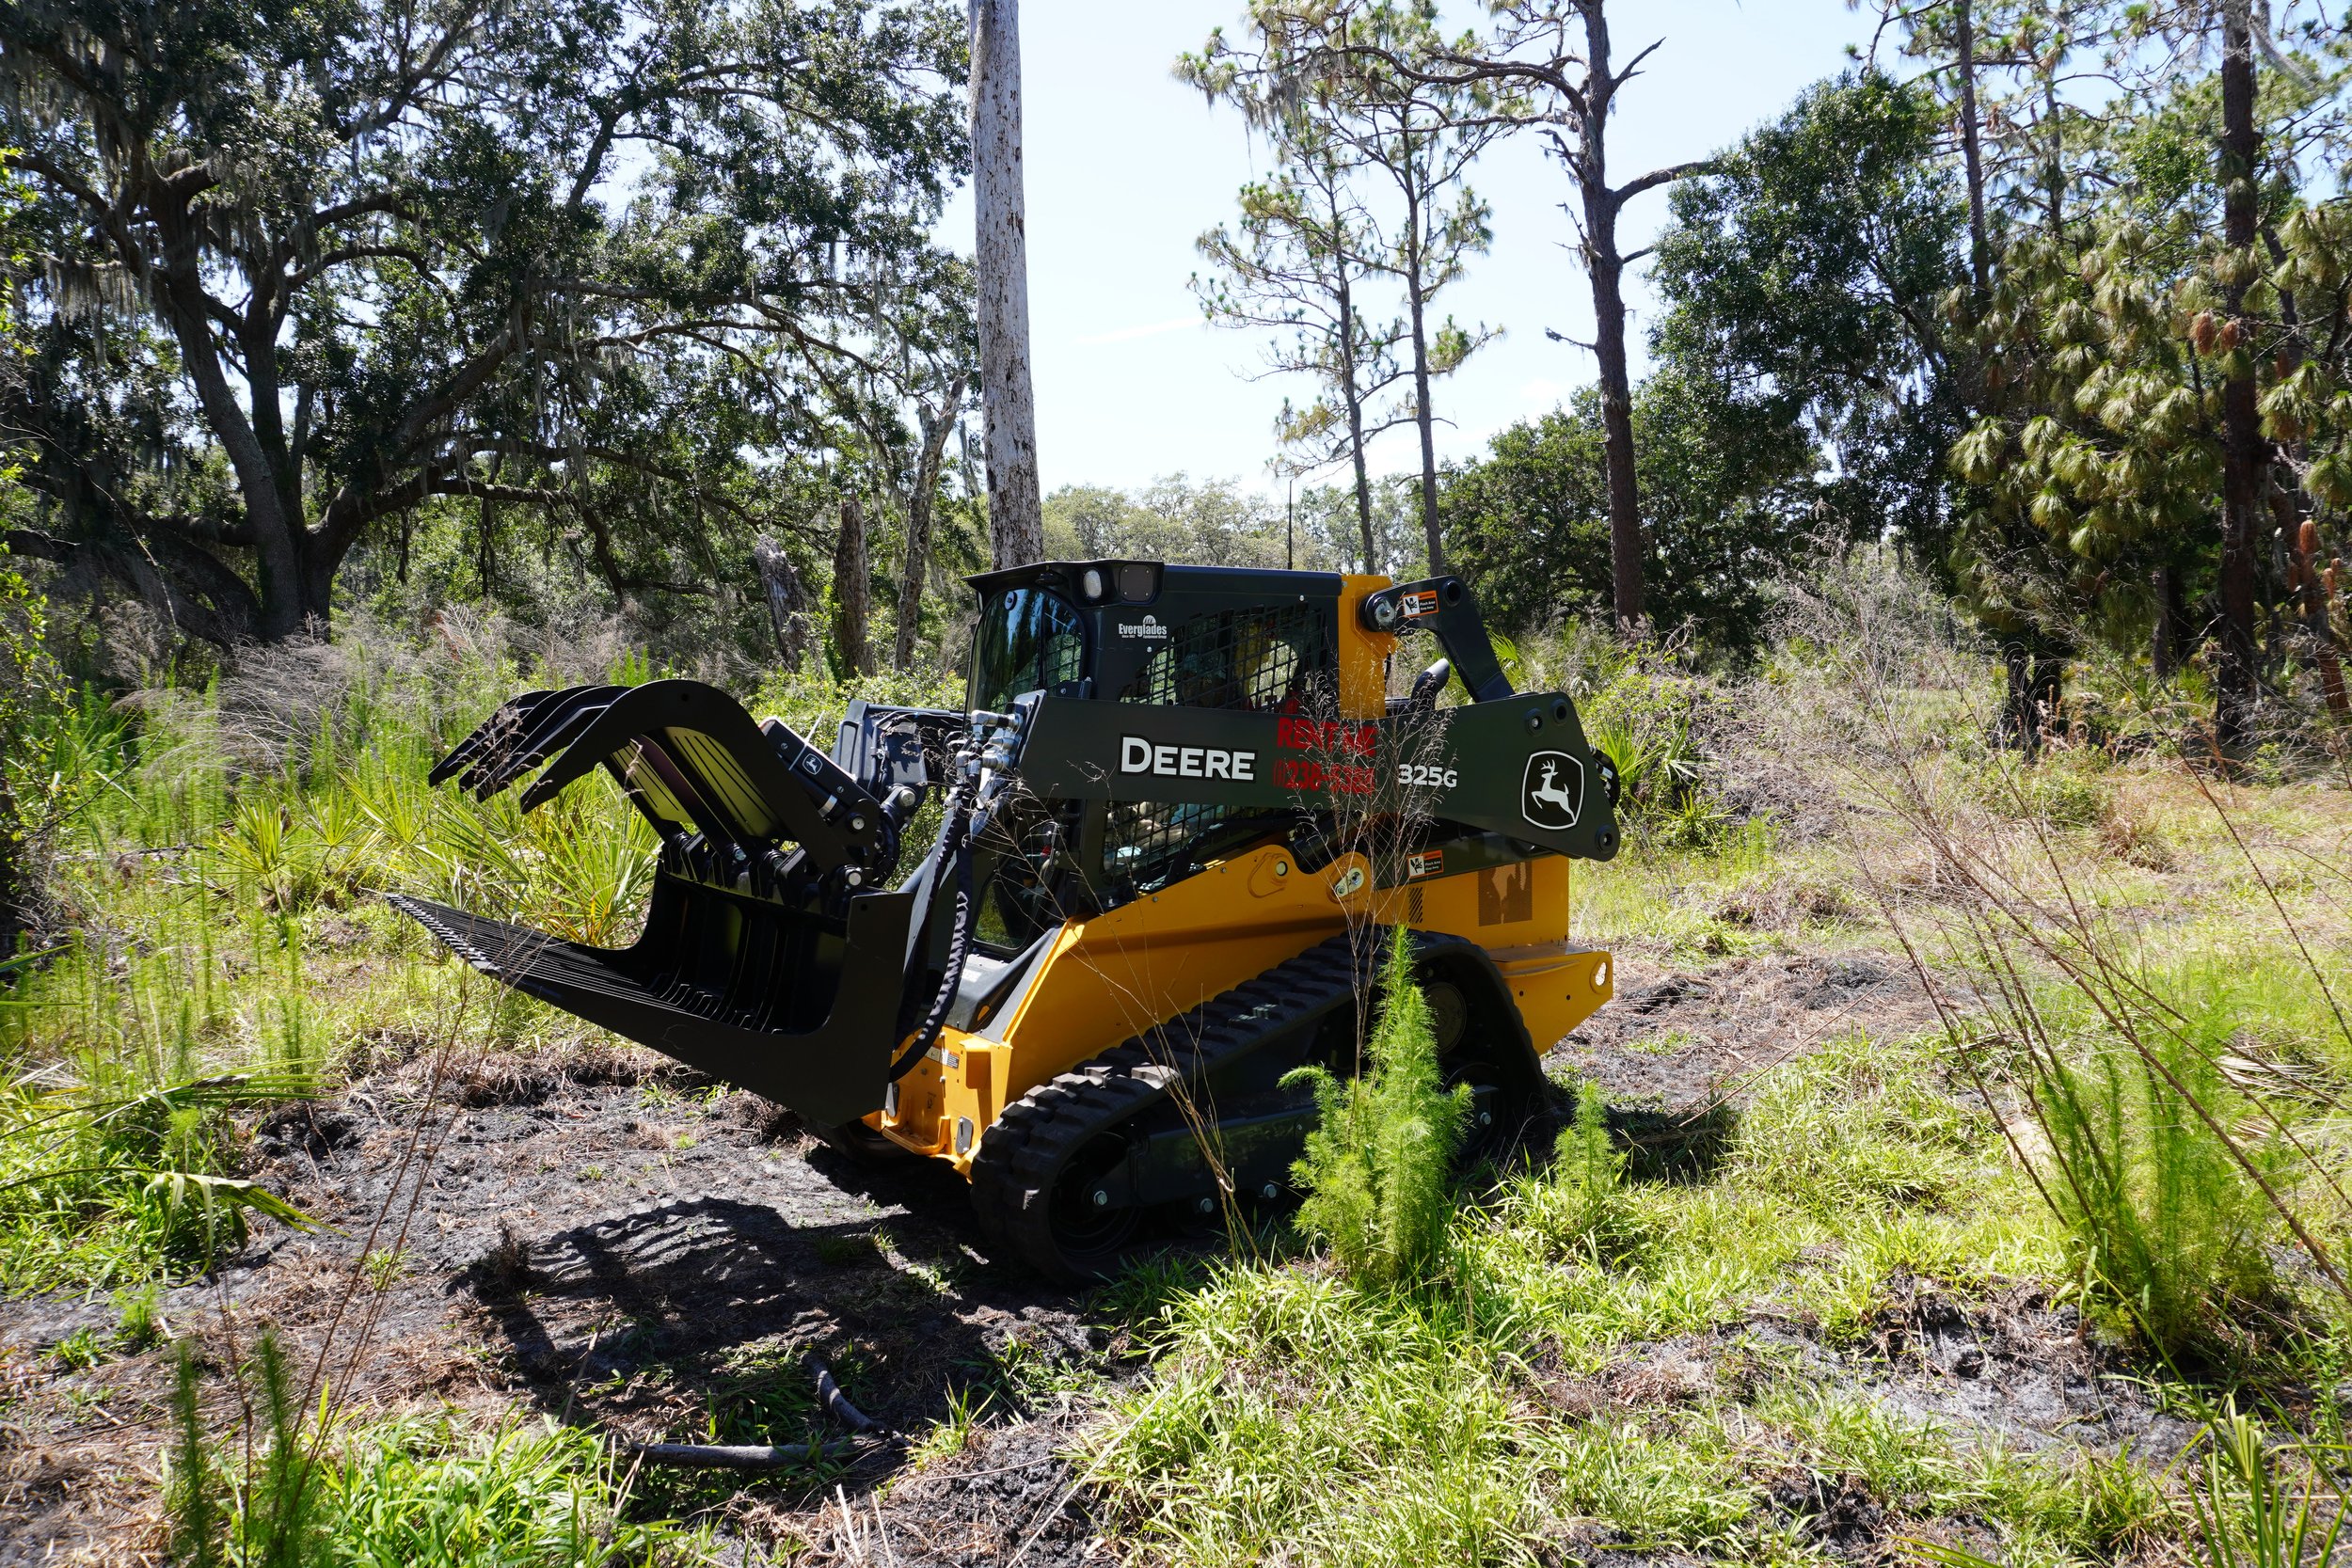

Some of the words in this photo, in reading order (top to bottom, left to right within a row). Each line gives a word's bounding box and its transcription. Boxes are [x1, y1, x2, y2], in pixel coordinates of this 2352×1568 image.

[1119, 623, 1168, 638] Everglades
[1277, 717, 1340, 753] RENT
[1120, 736, 1256, 781] DEERE
[1398, 764, 1458, 788] 325G
